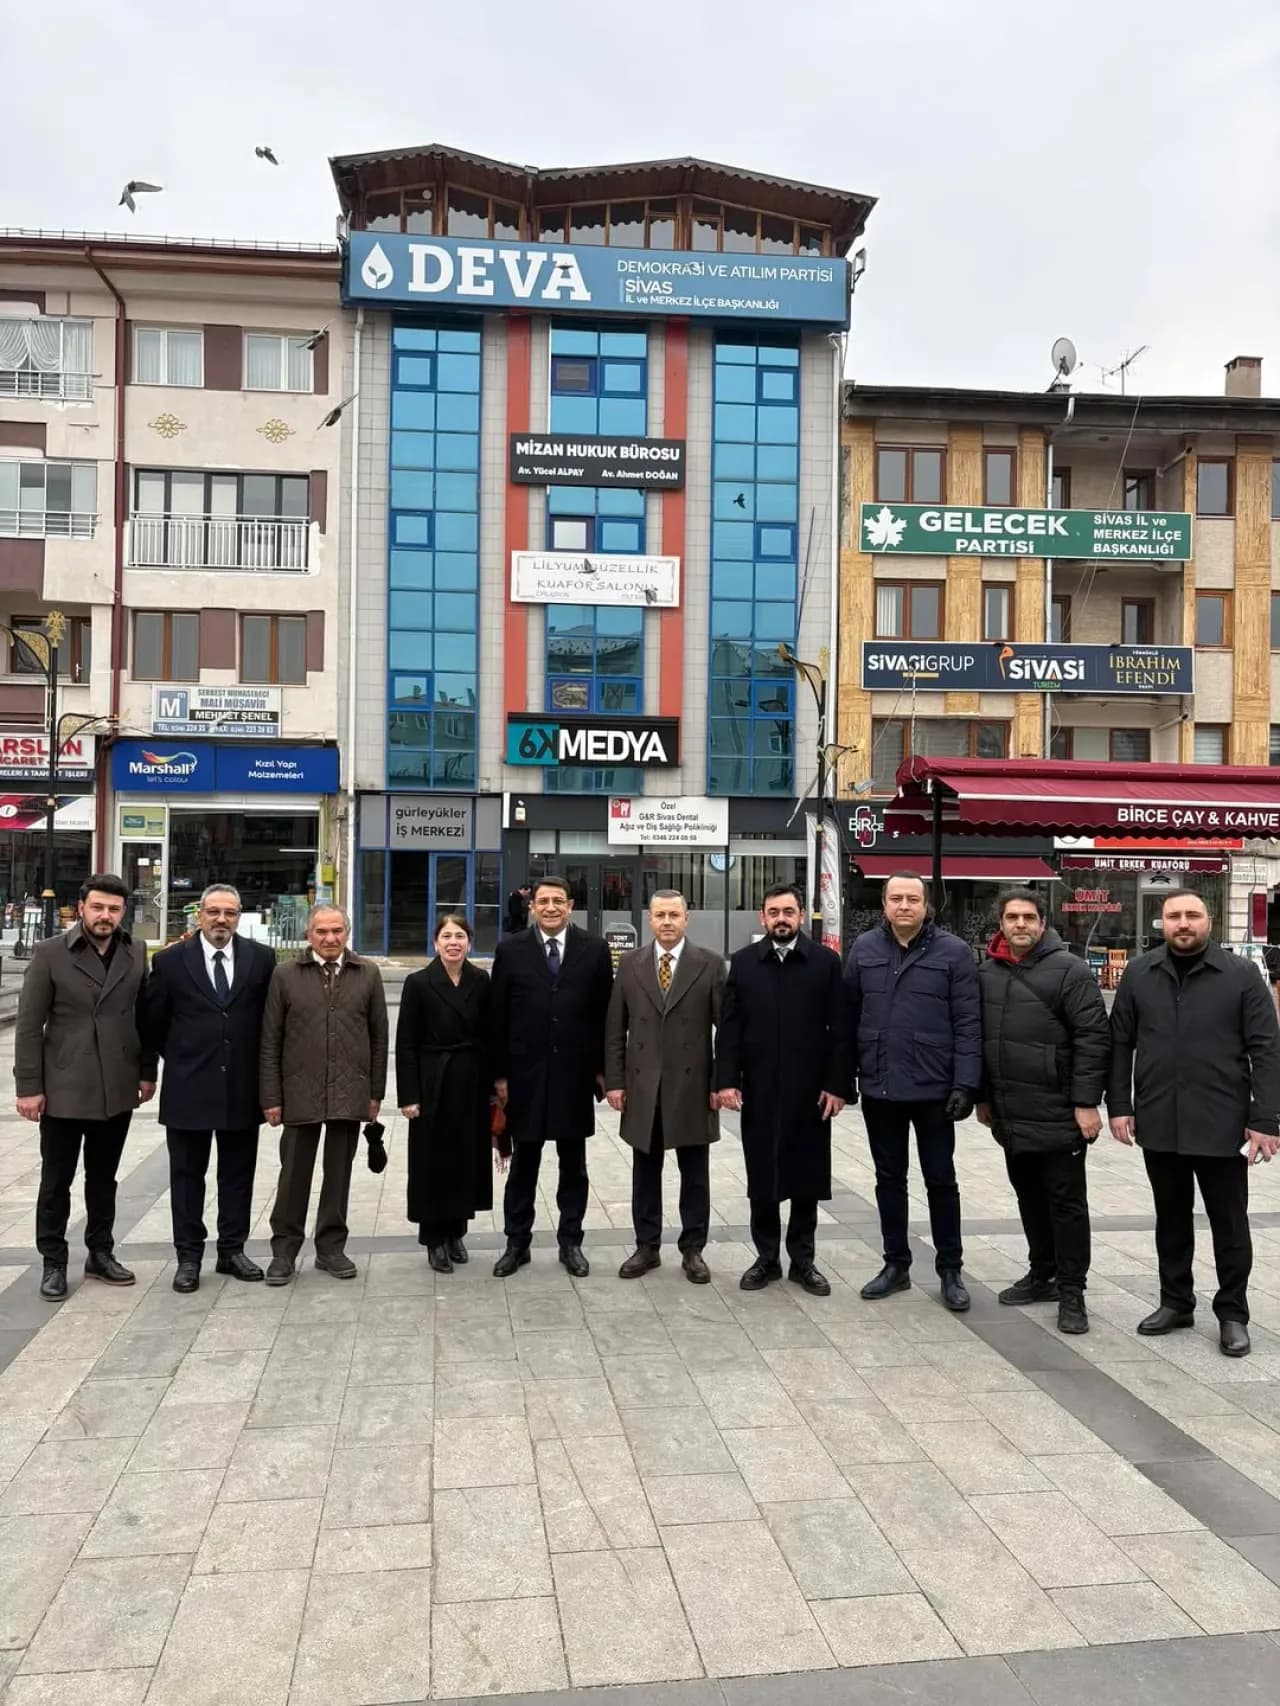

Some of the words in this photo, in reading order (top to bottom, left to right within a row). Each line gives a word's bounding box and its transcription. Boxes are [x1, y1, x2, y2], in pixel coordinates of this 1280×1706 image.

[408, 243, 592, 301] DEVA
[617, 260, 705, 277] DEMOKRASİ
[708, 264, 728, 278] VE
[729, 265, 777, 281] ATILIM
[780, 267, 833, 285] PARTİSİ
[625, 275, 673, 295] SİVAS
[637, 296, 649, 305] ve
[650, 295, 692, 307] MERKEZ
[693, 297, 716, 309] İLÇE
[717, 298, 780, 311] BAŞKANLIĞI
[516, 440, 564, 457] MİZAN
[566, 446, 617, 459] HUKUK
[619, 445, 680, 461] BÜROSU
[518, 466, 532, 475] Av.
[533, 467, 556, 477] Yücel
[557, 468, 585, 477] ALPAY
[602, 469, 616, 478] Av.
[617, 470, 644, 480] Ahmet
[645, 469, 679, 481] DOĞAN
[919, 510, 1069, 537] GELECEK
[1093, 512, 1133, 526] SİVAS
[1135, 513, 1148, 526] İL
[1150, 517, 1167, 527] ve
[1093, 527, 1149, 541] MERKEZ
[1151, 528, 1182, 543] İLÇE
[956, 538, 1035, 555] PARTİSİ
[1093, 541, 1175, 556] BAŞKANLIĞI
[1109, 652, 1181, 670] İBRAHİM
[1009, 659, 1085, 681] SİVASİ
[1116, 670, 1175, 686] EFENDİ
[0, 738, 82, 757] RSLN
[559, 729, 668, 762] MEDYA
[129, 761, 190, 775] Marshall
[248, 771, 305, 781] Malzemeleri
[660, 801, 677, 810] Özel
[395, 807, 467, 821] gürleyükler
[1117, 805, 1168, 824] BİRCE
[1171, 810, 1204, 828] ÇAY
[1207, 811, 1220, 825] &
[1224, 812, 1280, 828] KAHVE
[396, 823, 408, 839] İŞ
[411, 824, 465, 838] MERKEZİ
[1119, 859, 1146, 869] ERKEK
